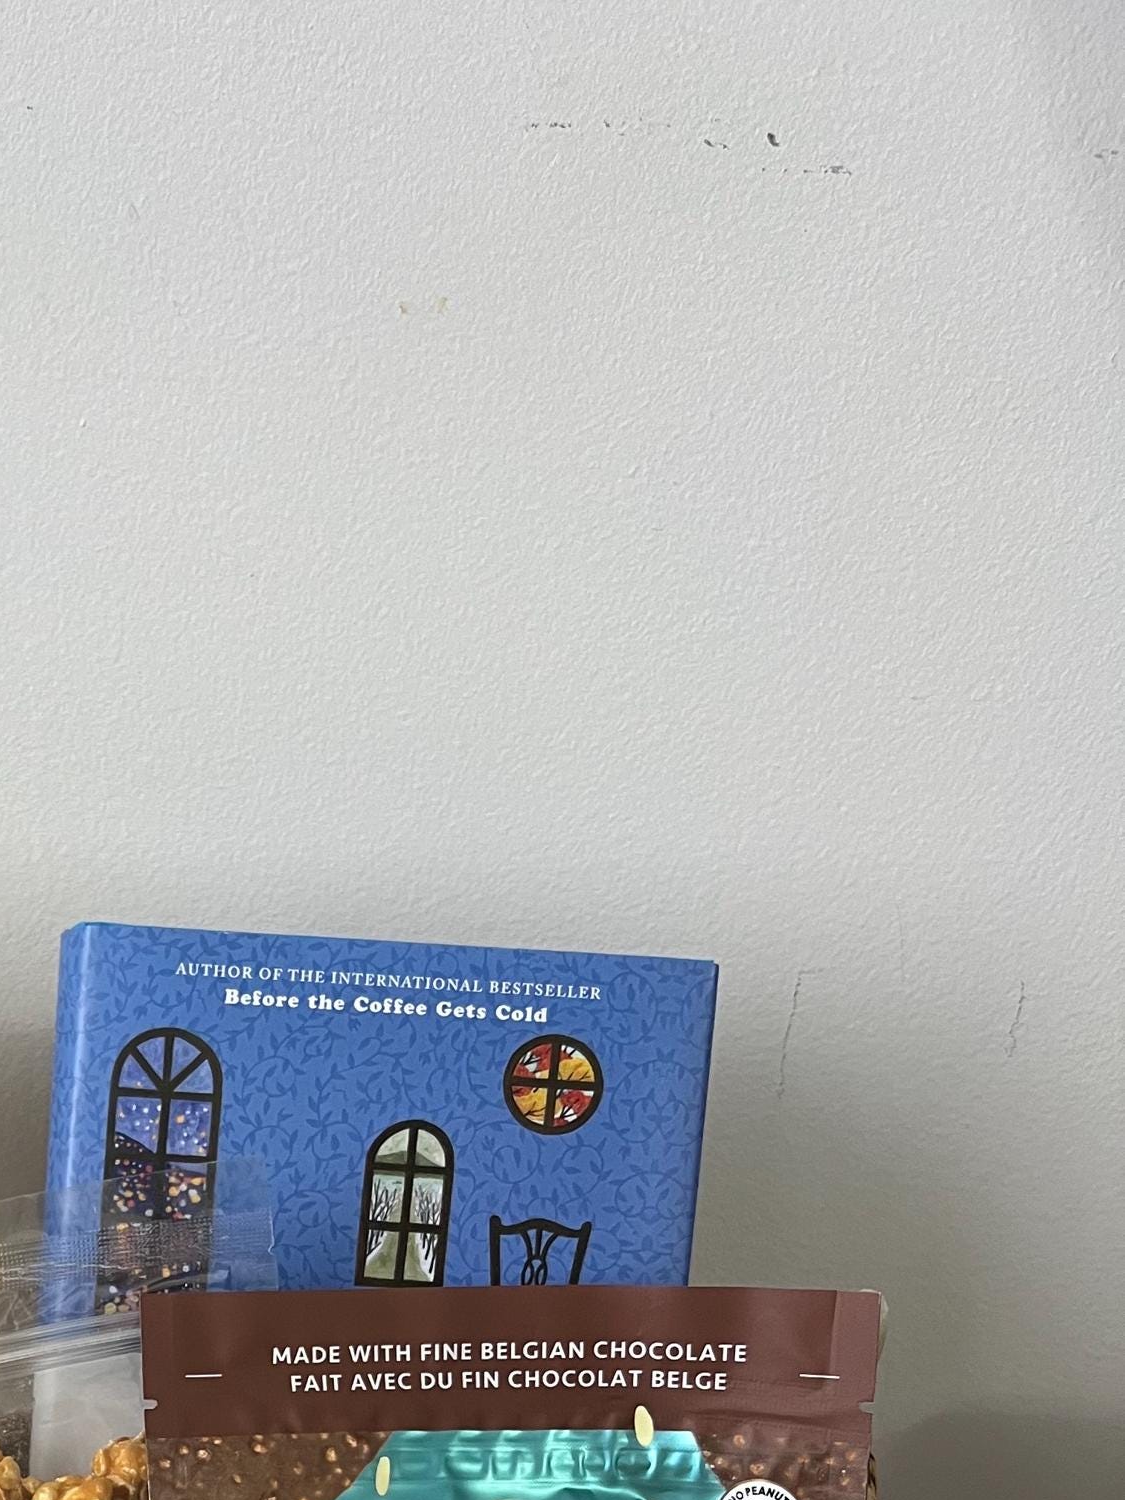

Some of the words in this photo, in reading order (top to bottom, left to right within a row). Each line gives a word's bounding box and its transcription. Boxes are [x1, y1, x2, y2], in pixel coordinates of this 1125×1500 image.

[175, 962, 253, 980] AUTHOR
[258, 967, 284, 981] OF
[287, 968, 326, 984] THE
[330, 971, 483, 993] INTERNATIONAL
[488, 980, 602, 1001] BESTSELLER
[224, 988, 300, 1009] Before
[307, 994, 345, 1011] the
[352, 995, 427, 1016] Coffee
[435, 1001, 487, 1020] Gets
[494, 1004, 548, 1024] Cold
[271, 1345, 341, 1365] MADE
[348, 1344, 411, 1363] WITH
[420, 1343, 473, 1362] FINE
[480, 1341, 585, 1361] BELGIAN
[592, 1340, 748, 1363] CHOCOLATE
[289, 1374, 343, 1393] FAIT
[350, 1372, 412, 1391] AVEC
[419, 1371, 453, 1390] DU
[461, 1370, 500, 1389] FIN
[507, 1369, 643, 1388] CHOCOLAT
[650, 1370, 728, 1391] BELGE
